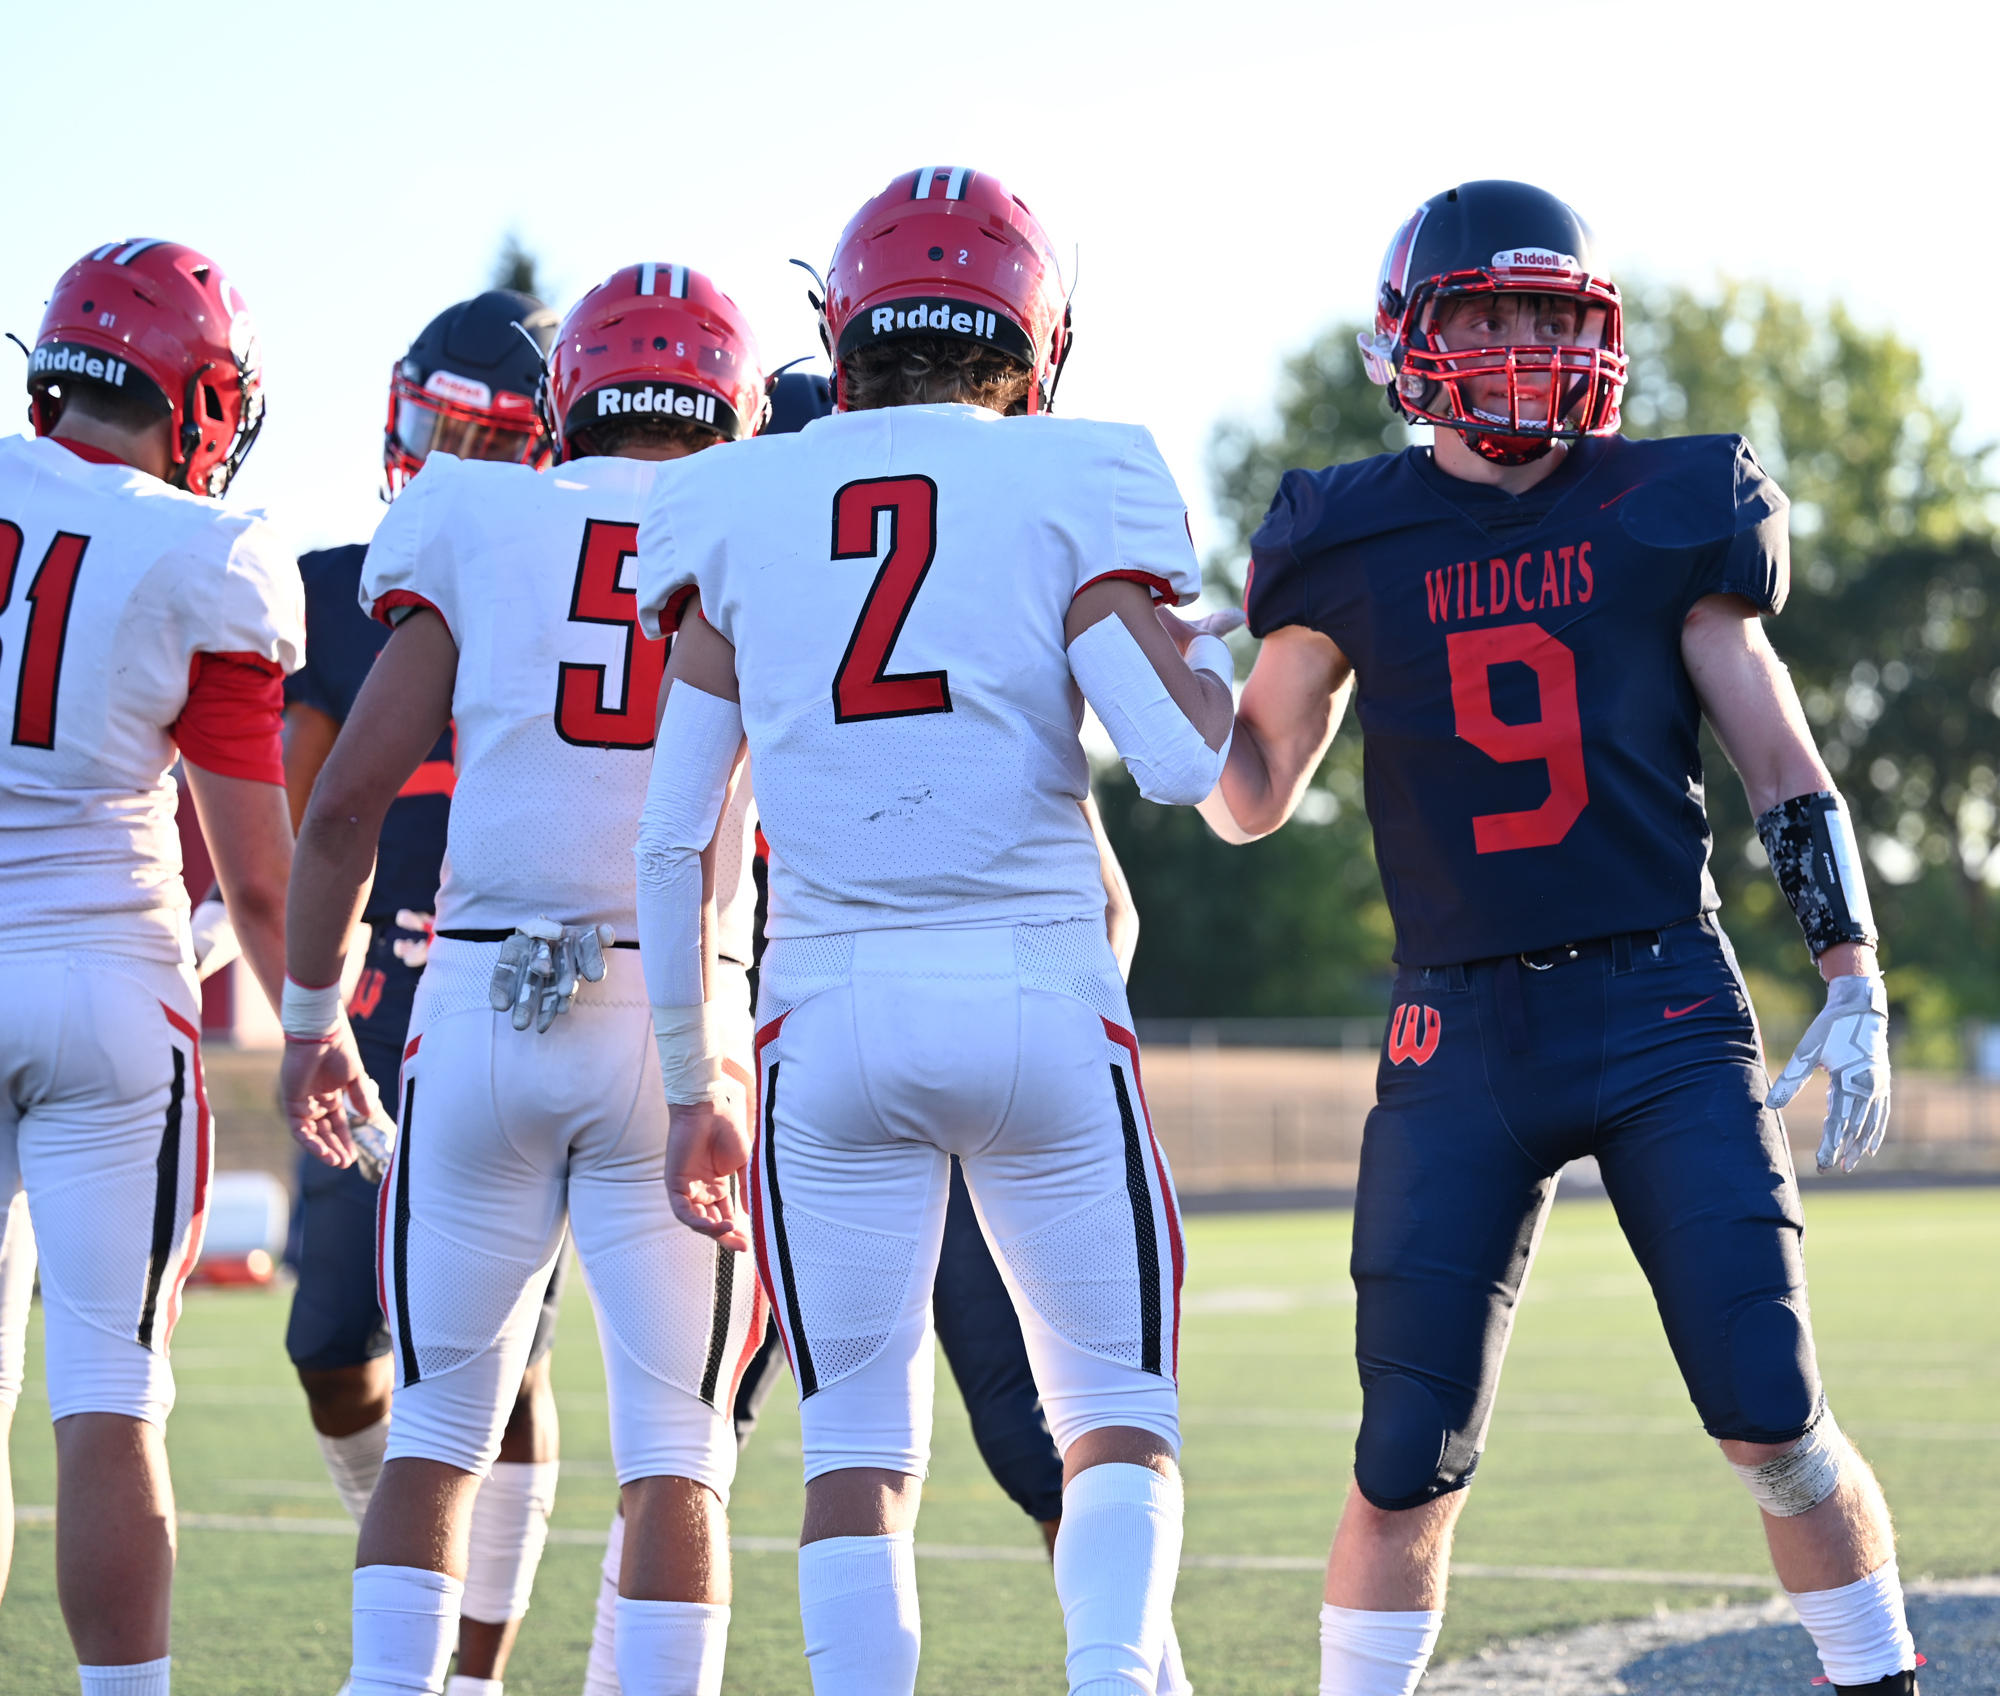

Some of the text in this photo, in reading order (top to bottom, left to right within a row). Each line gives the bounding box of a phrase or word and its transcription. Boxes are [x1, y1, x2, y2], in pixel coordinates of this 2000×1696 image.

[958, 249, 968, 265] 2
[1513, 252, 1559, 267] Riddell
[99, 311, 116, 328] 81
[871, 303, 997, 340] Riddell
[33, 346, 127, 387] Riddell
[675, 342, 685, 357] 5
[597, 386, 716, 424] Riddell
[831, 474, 953, 724] 2
[1425, 541, 1594, 624] WILDCATS
[0, 518, 92, 751] 1
[554, 518, 673, 751] 5
[1446, 622, 1589, 854] 9
[1388, 1003, 1441, 1066] W
